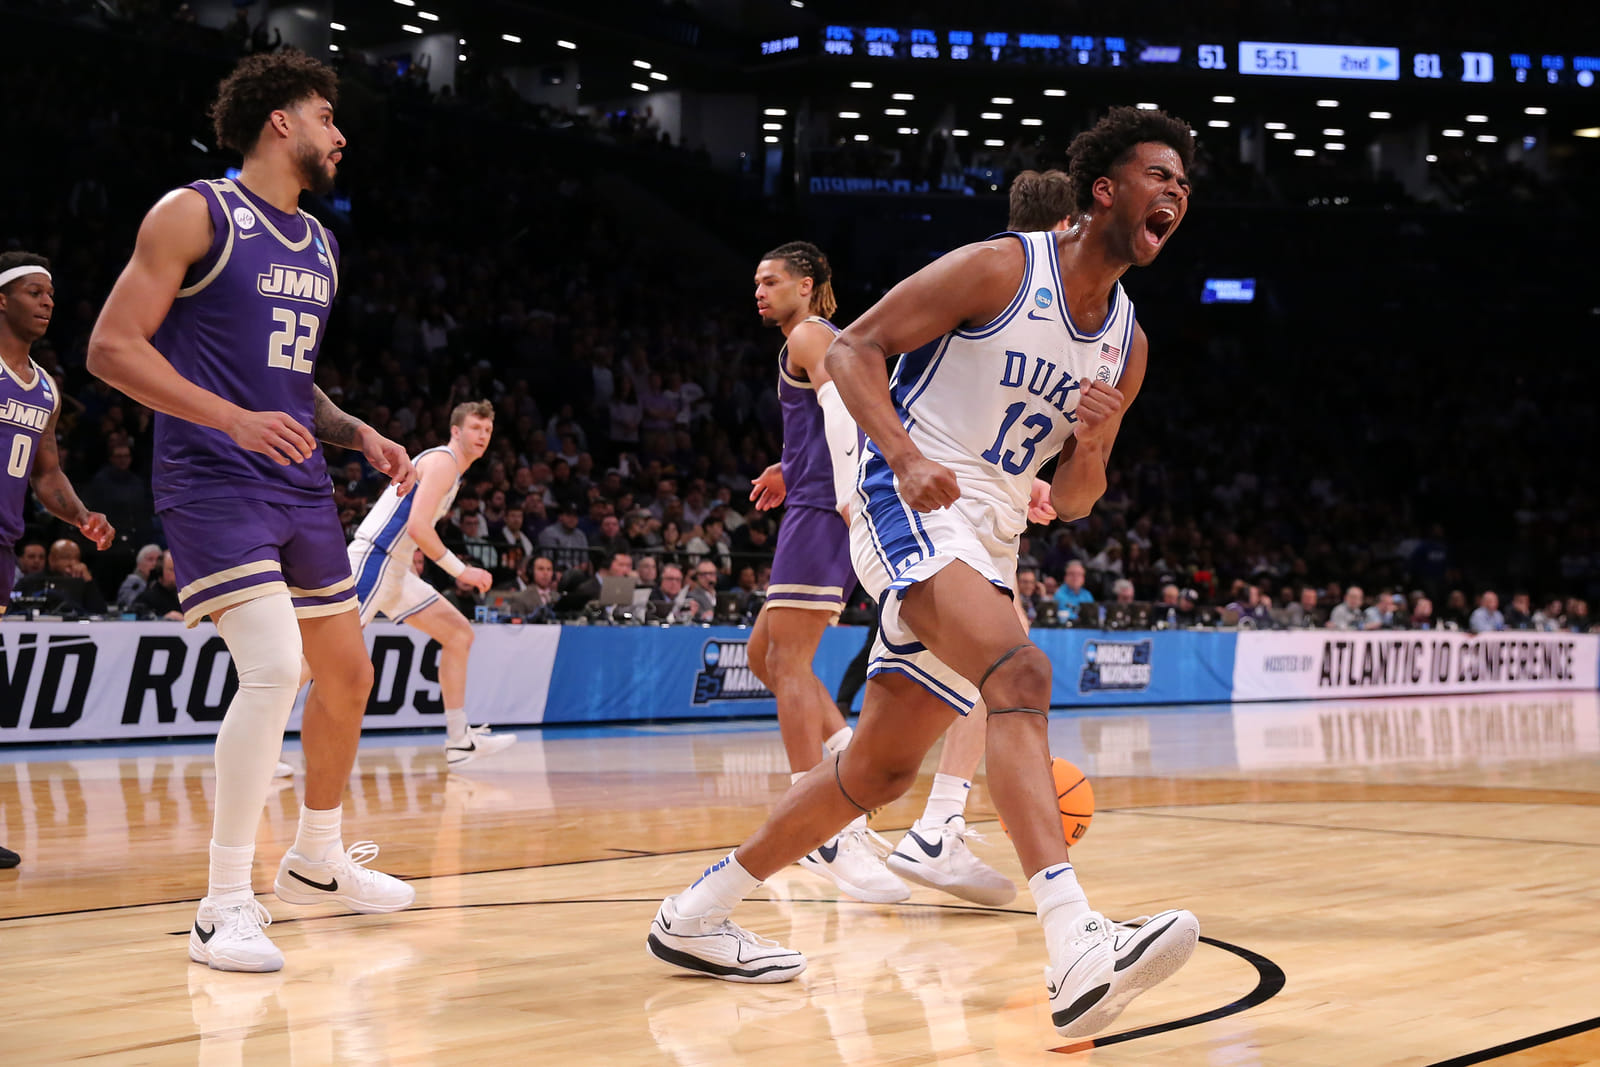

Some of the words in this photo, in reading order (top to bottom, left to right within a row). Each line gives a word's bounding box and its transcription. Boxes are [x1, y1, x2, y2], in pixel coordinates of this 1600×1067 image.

[1198, 45, 1227, 69] 51
[1256, 50, 1299, 71] 5:51
[1341, 55, 1370, 71] 2nd
[1414, 54, 1443, 78] 81
[259, 266, 330, 305] JMU
[268, 307, 320, 374] 22
[0, 402, 49, 431] JMU
[7, 433, 32, 478] 0
[981, 401, 1054, 476] 13
[1319, 641, 1423, 687] ATLANTIC
[1456, 641, 1575, 682] CONFERENCE
